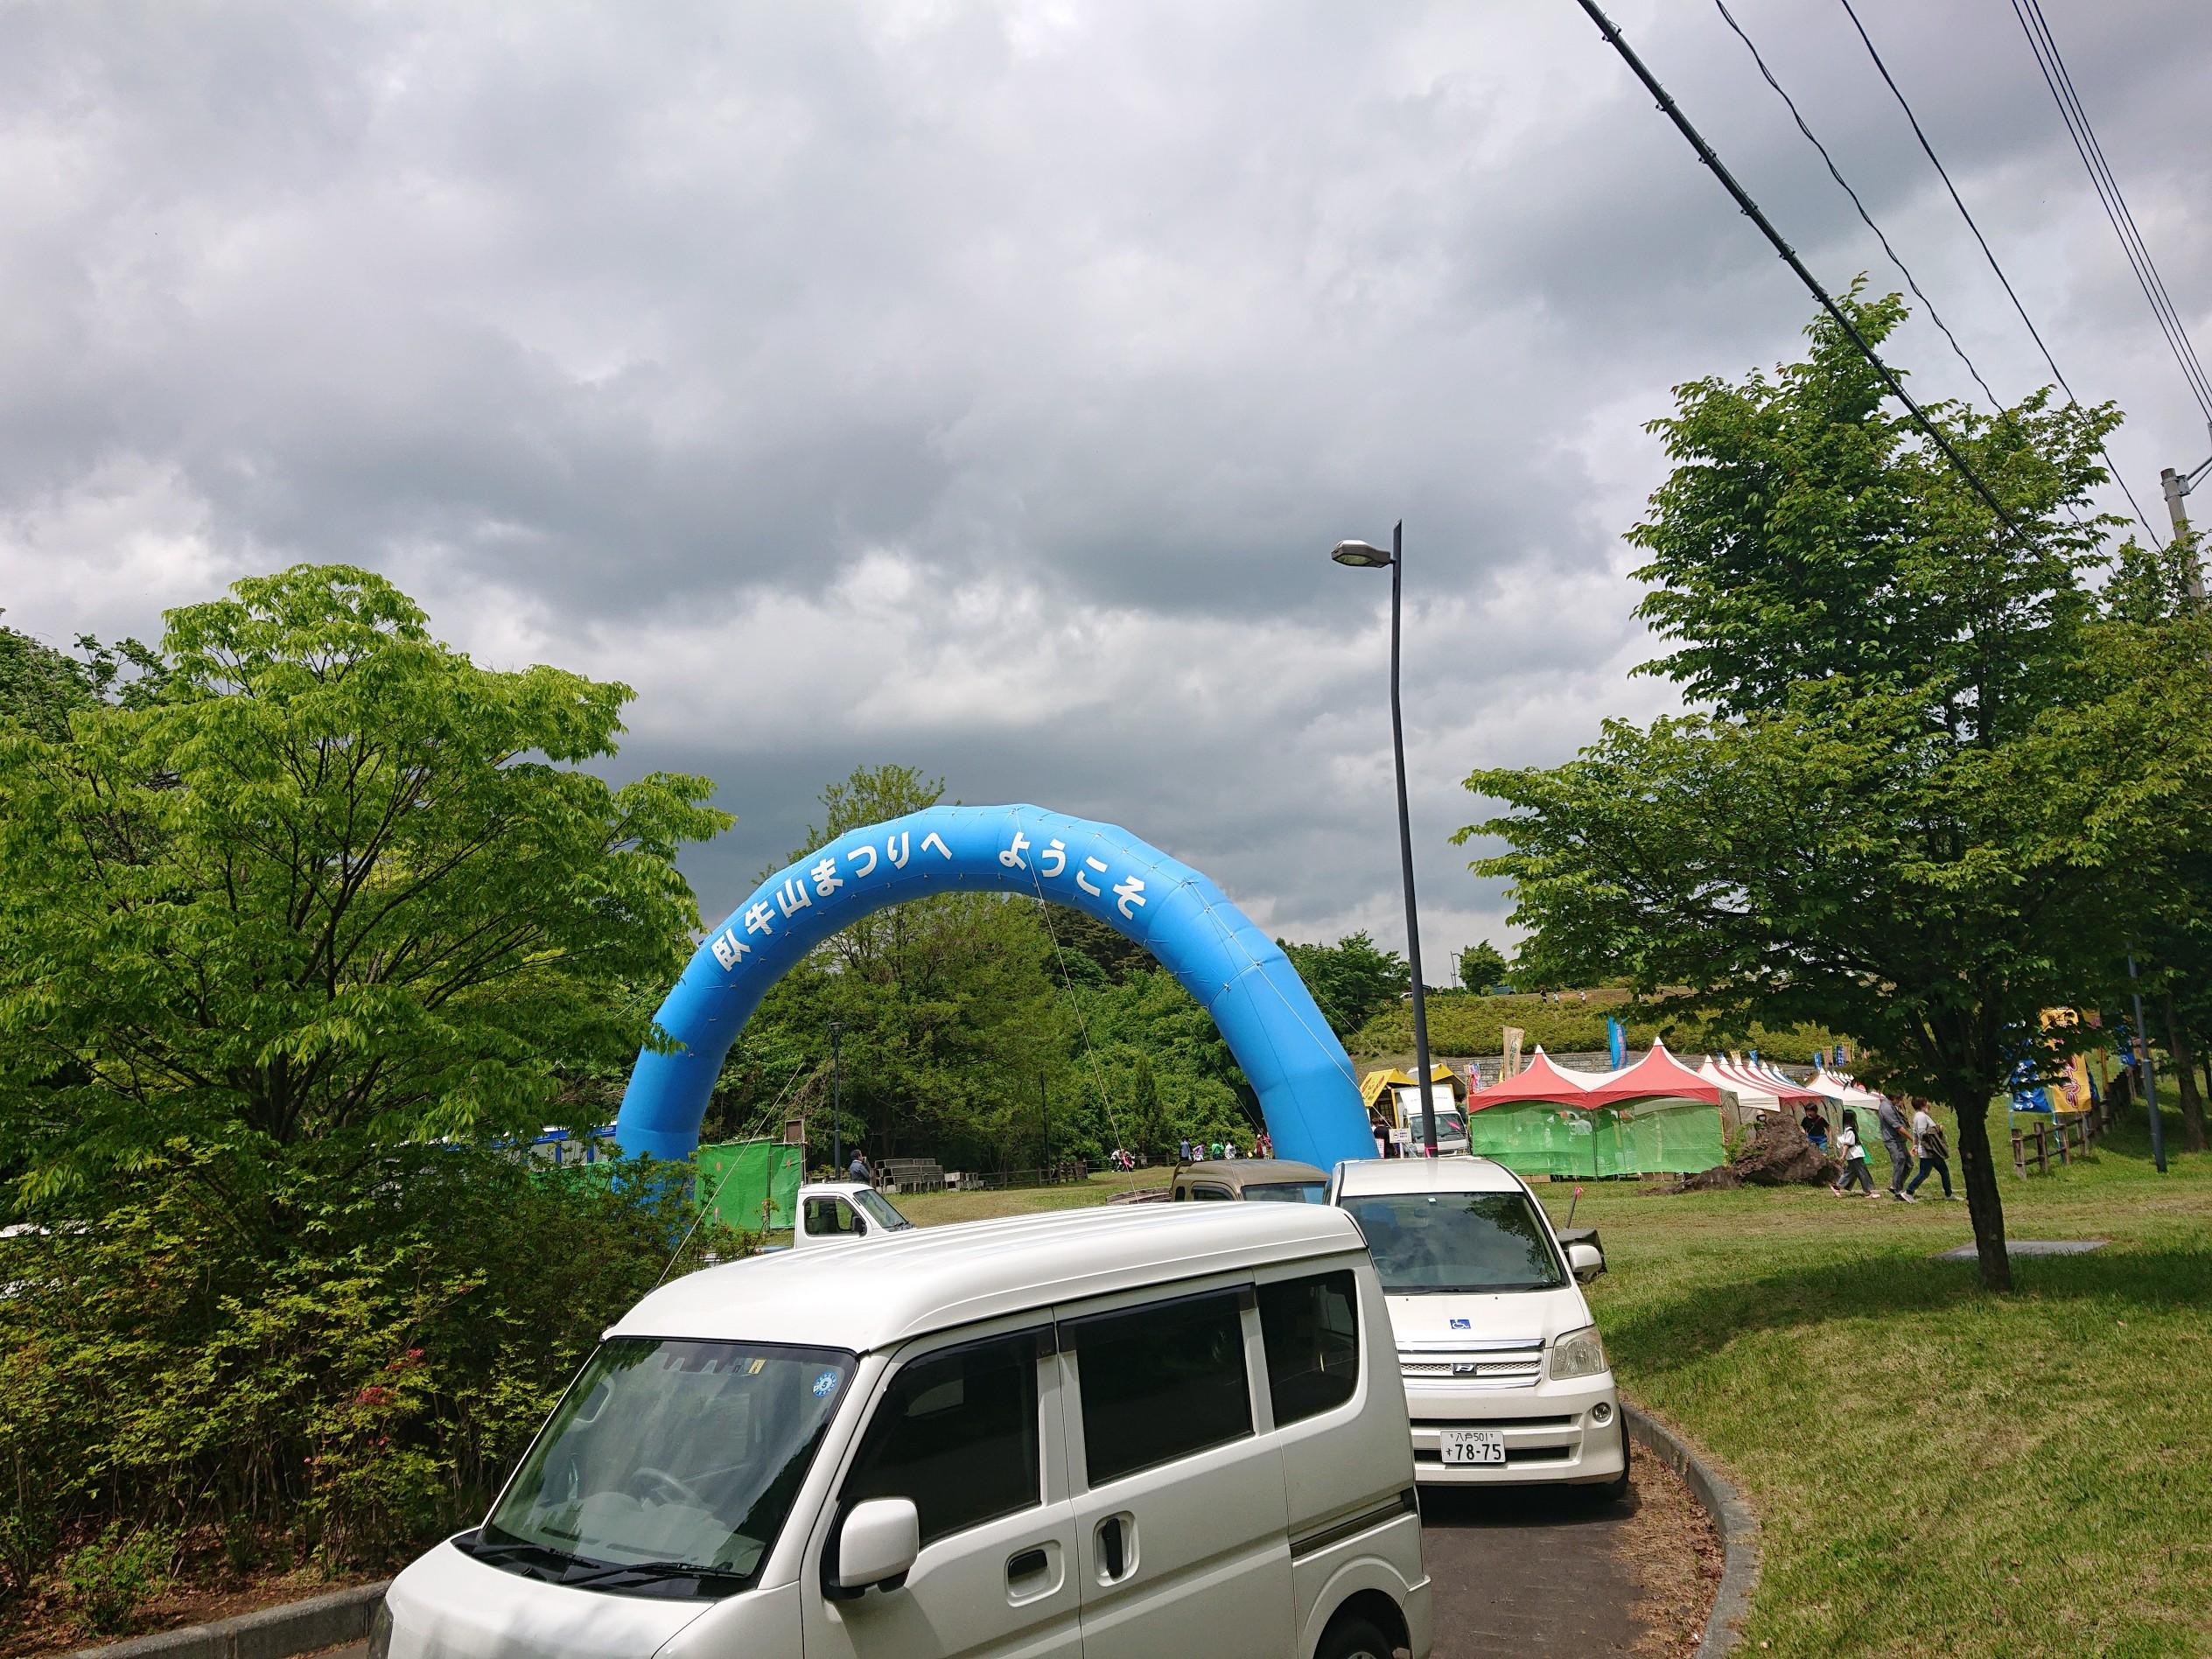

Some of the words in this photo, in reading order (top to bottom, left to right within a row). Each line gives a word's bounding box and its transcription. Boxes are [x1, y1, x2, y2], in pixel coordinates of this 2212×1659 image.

[710, 831, 953, 972] 臥牛山まつりへ
[998, 831, 1146, 920] ようこそ
[1456, 1432, 1488, 1442] 八戸501
[1454, 1443, 1502, 1460] 78-75
